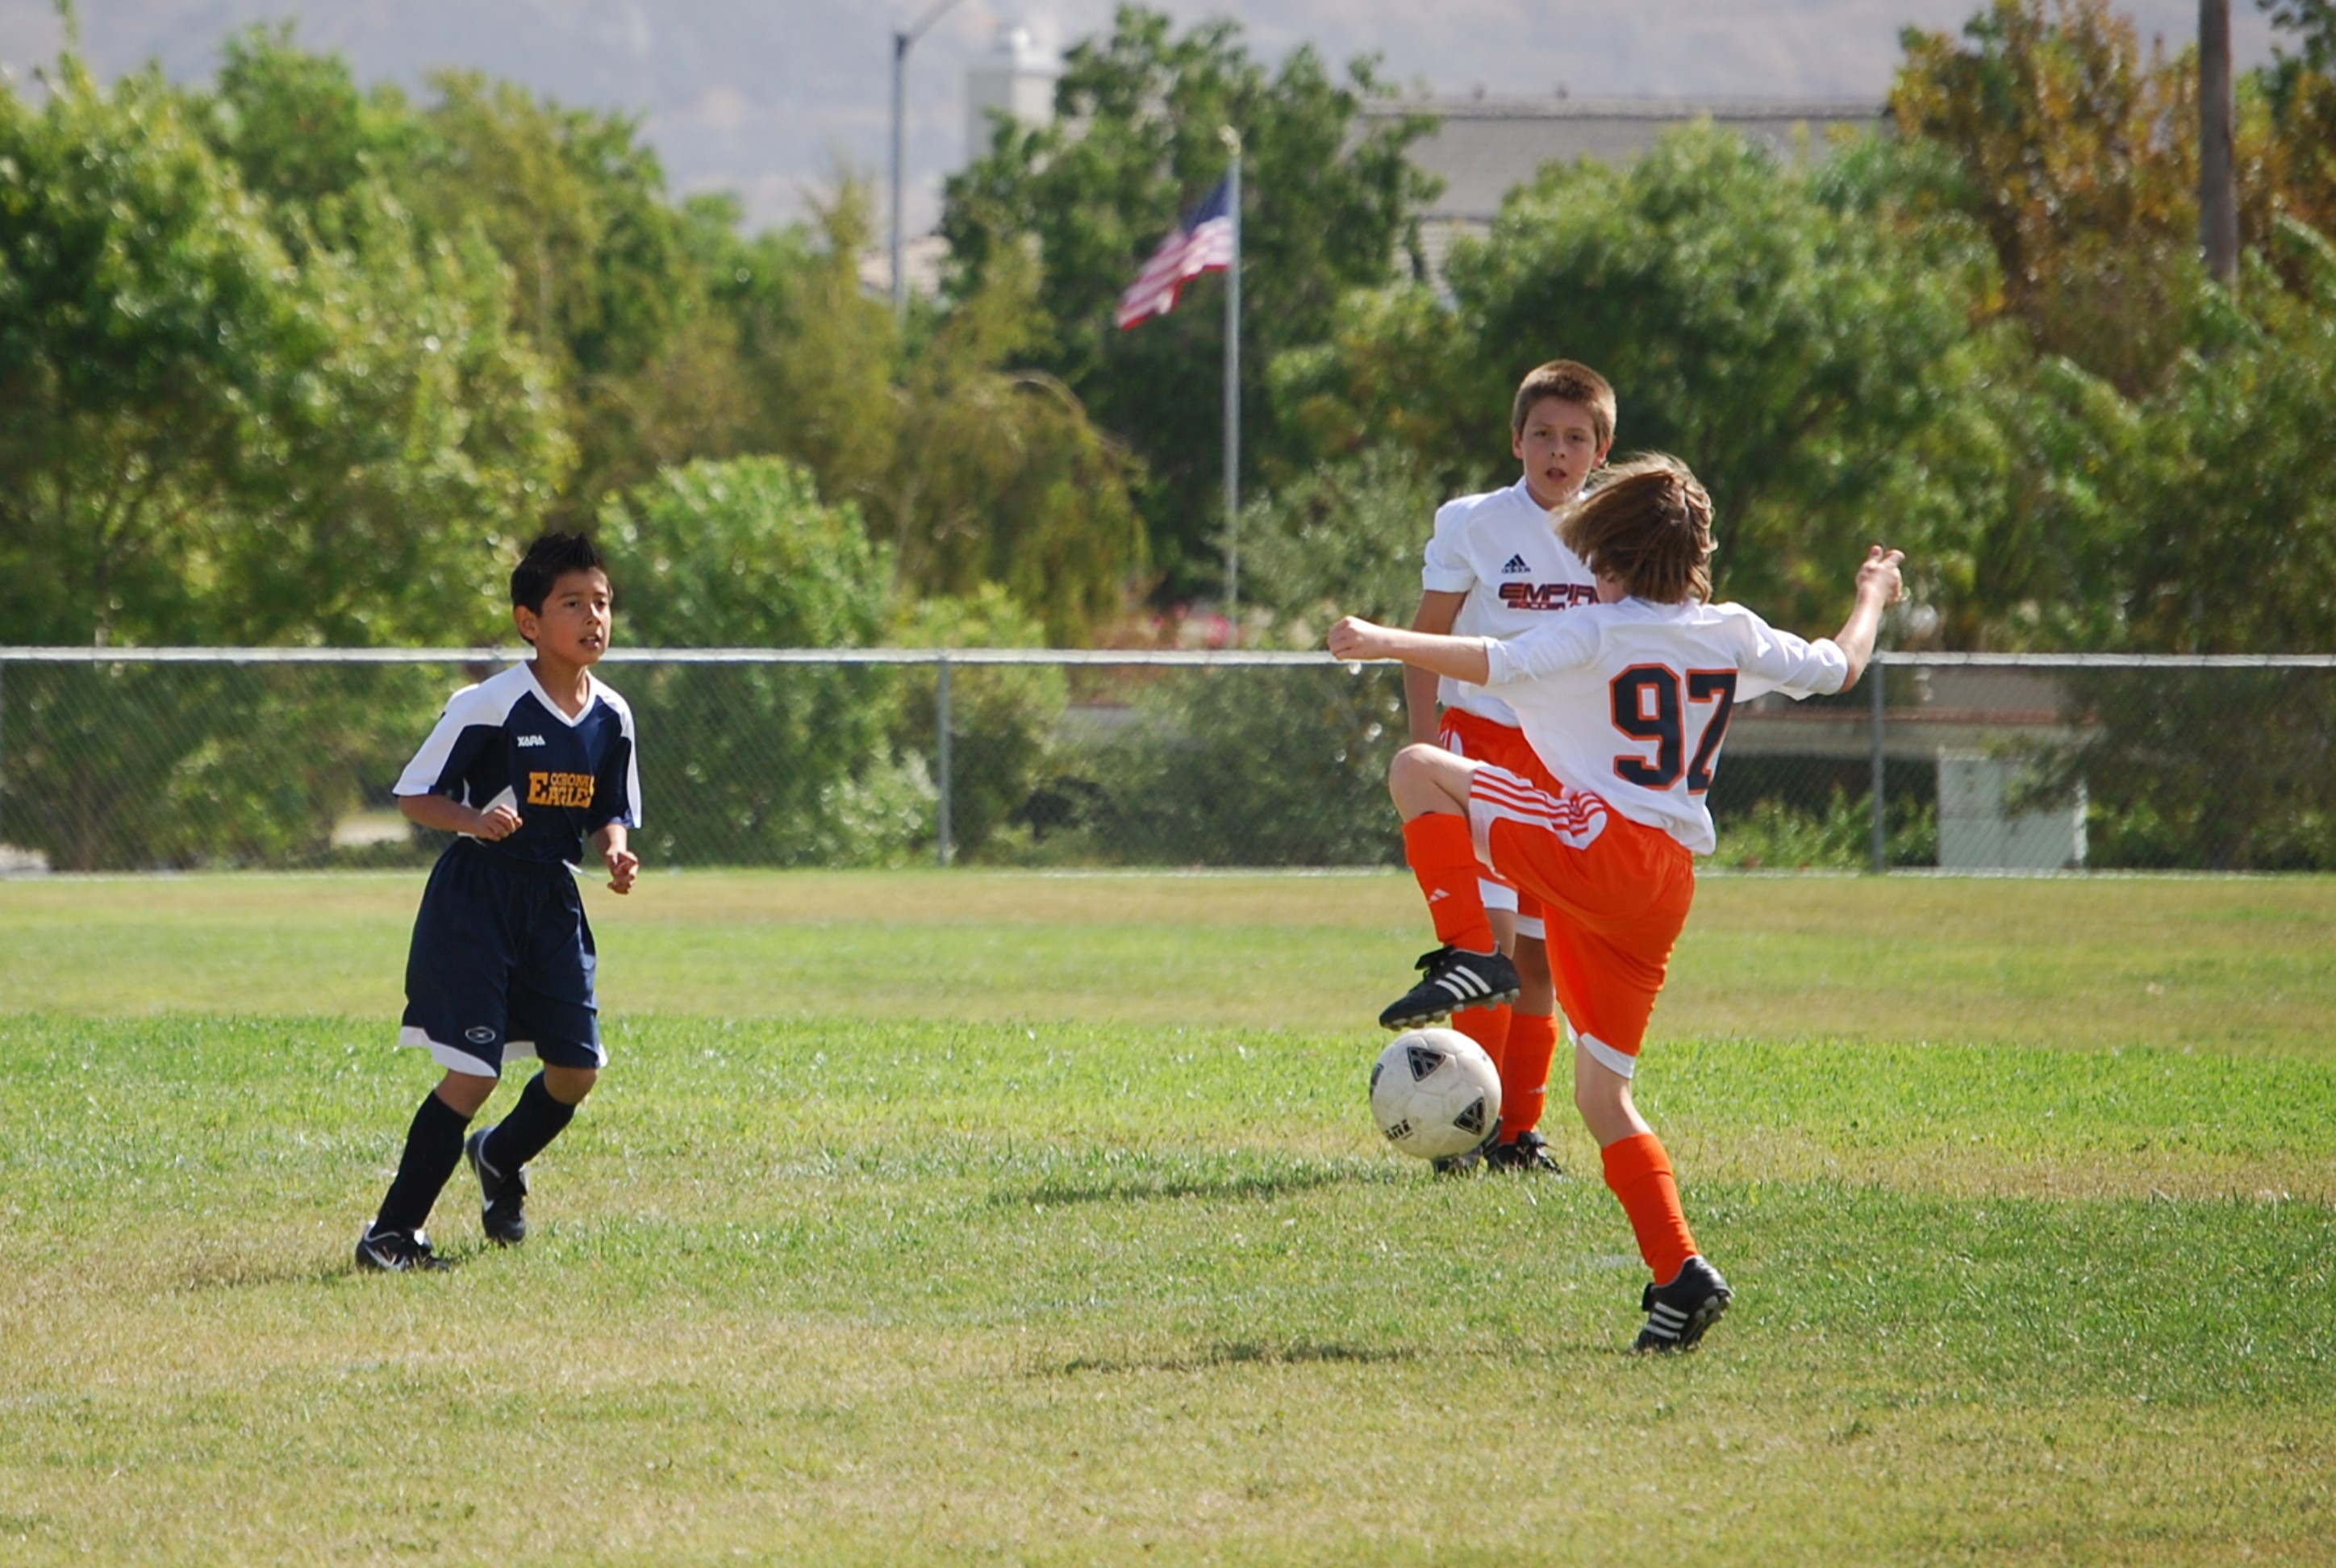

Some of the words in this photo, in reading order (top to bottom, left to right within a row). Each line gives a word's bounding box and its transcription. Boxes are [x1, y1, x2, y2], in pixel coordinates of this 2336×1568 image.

[1499, 582, 1601, 604] EMPIR
[1609, 662, 1738, 795] 97
[517, 735, 546, 747] XARA
